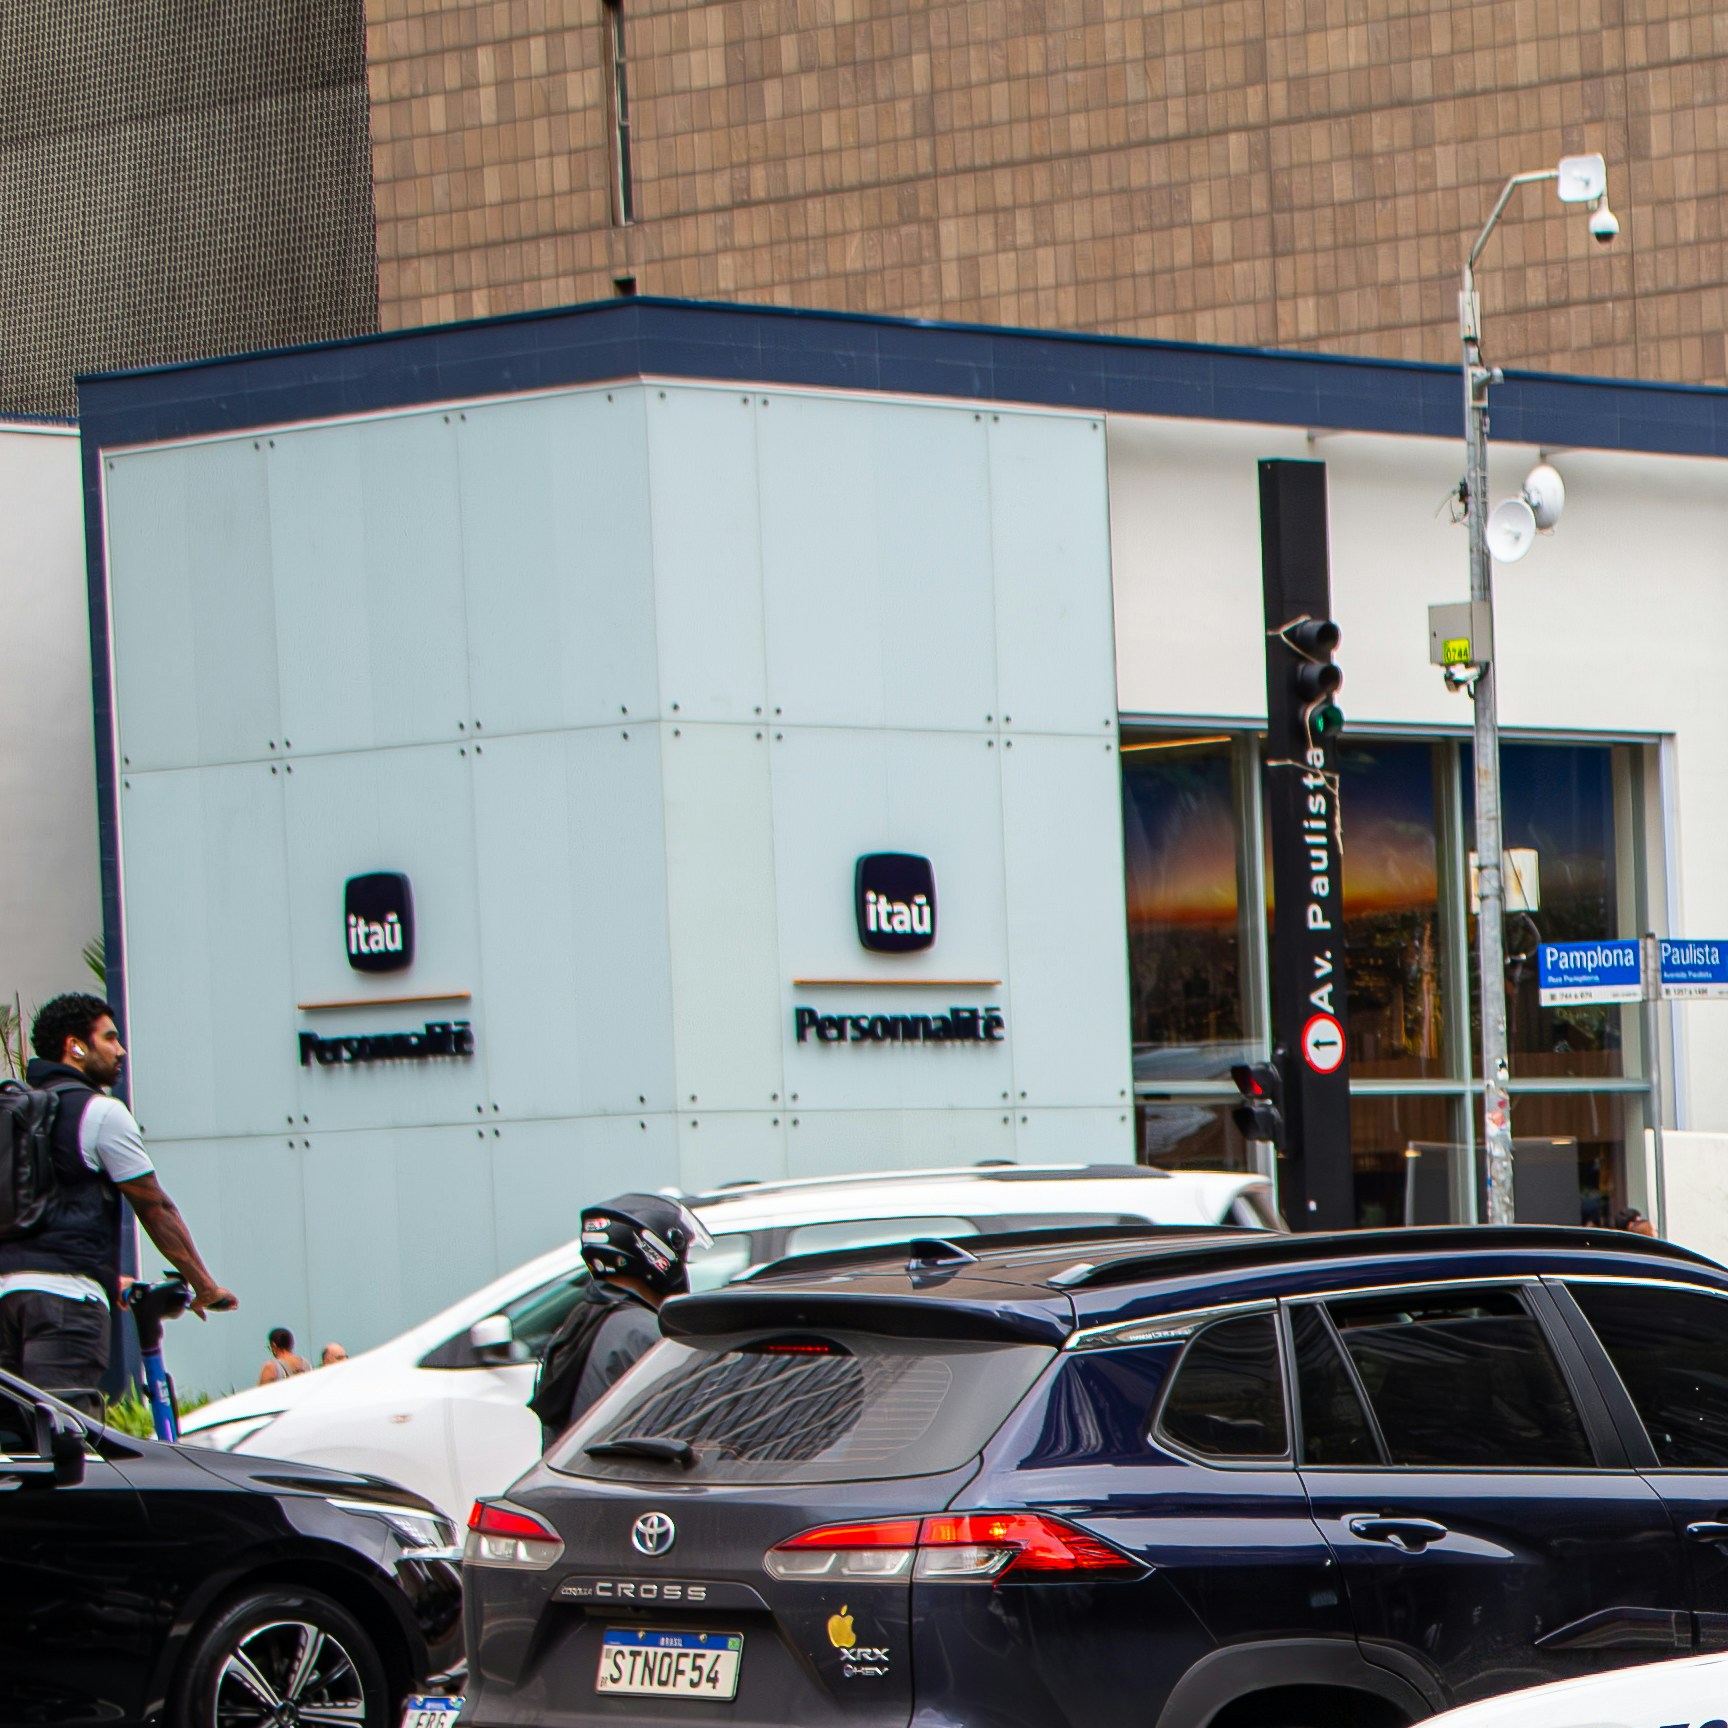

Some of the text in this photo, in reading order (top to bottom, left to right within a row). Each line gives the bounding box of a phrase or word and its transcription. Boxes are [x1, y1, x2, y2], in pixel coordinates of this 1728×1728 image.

[1303, 747, 1334, 1015] Av. Paulista
[1546, 945, 1635, 972] Pamplona
[1661, 942, 1720, 965] Paulista
[794, 1006, 1005, 1042] Personnalité
[596, 1582, 707, 1600] CROSS
[840, 1648, 890, 1661] XRX
